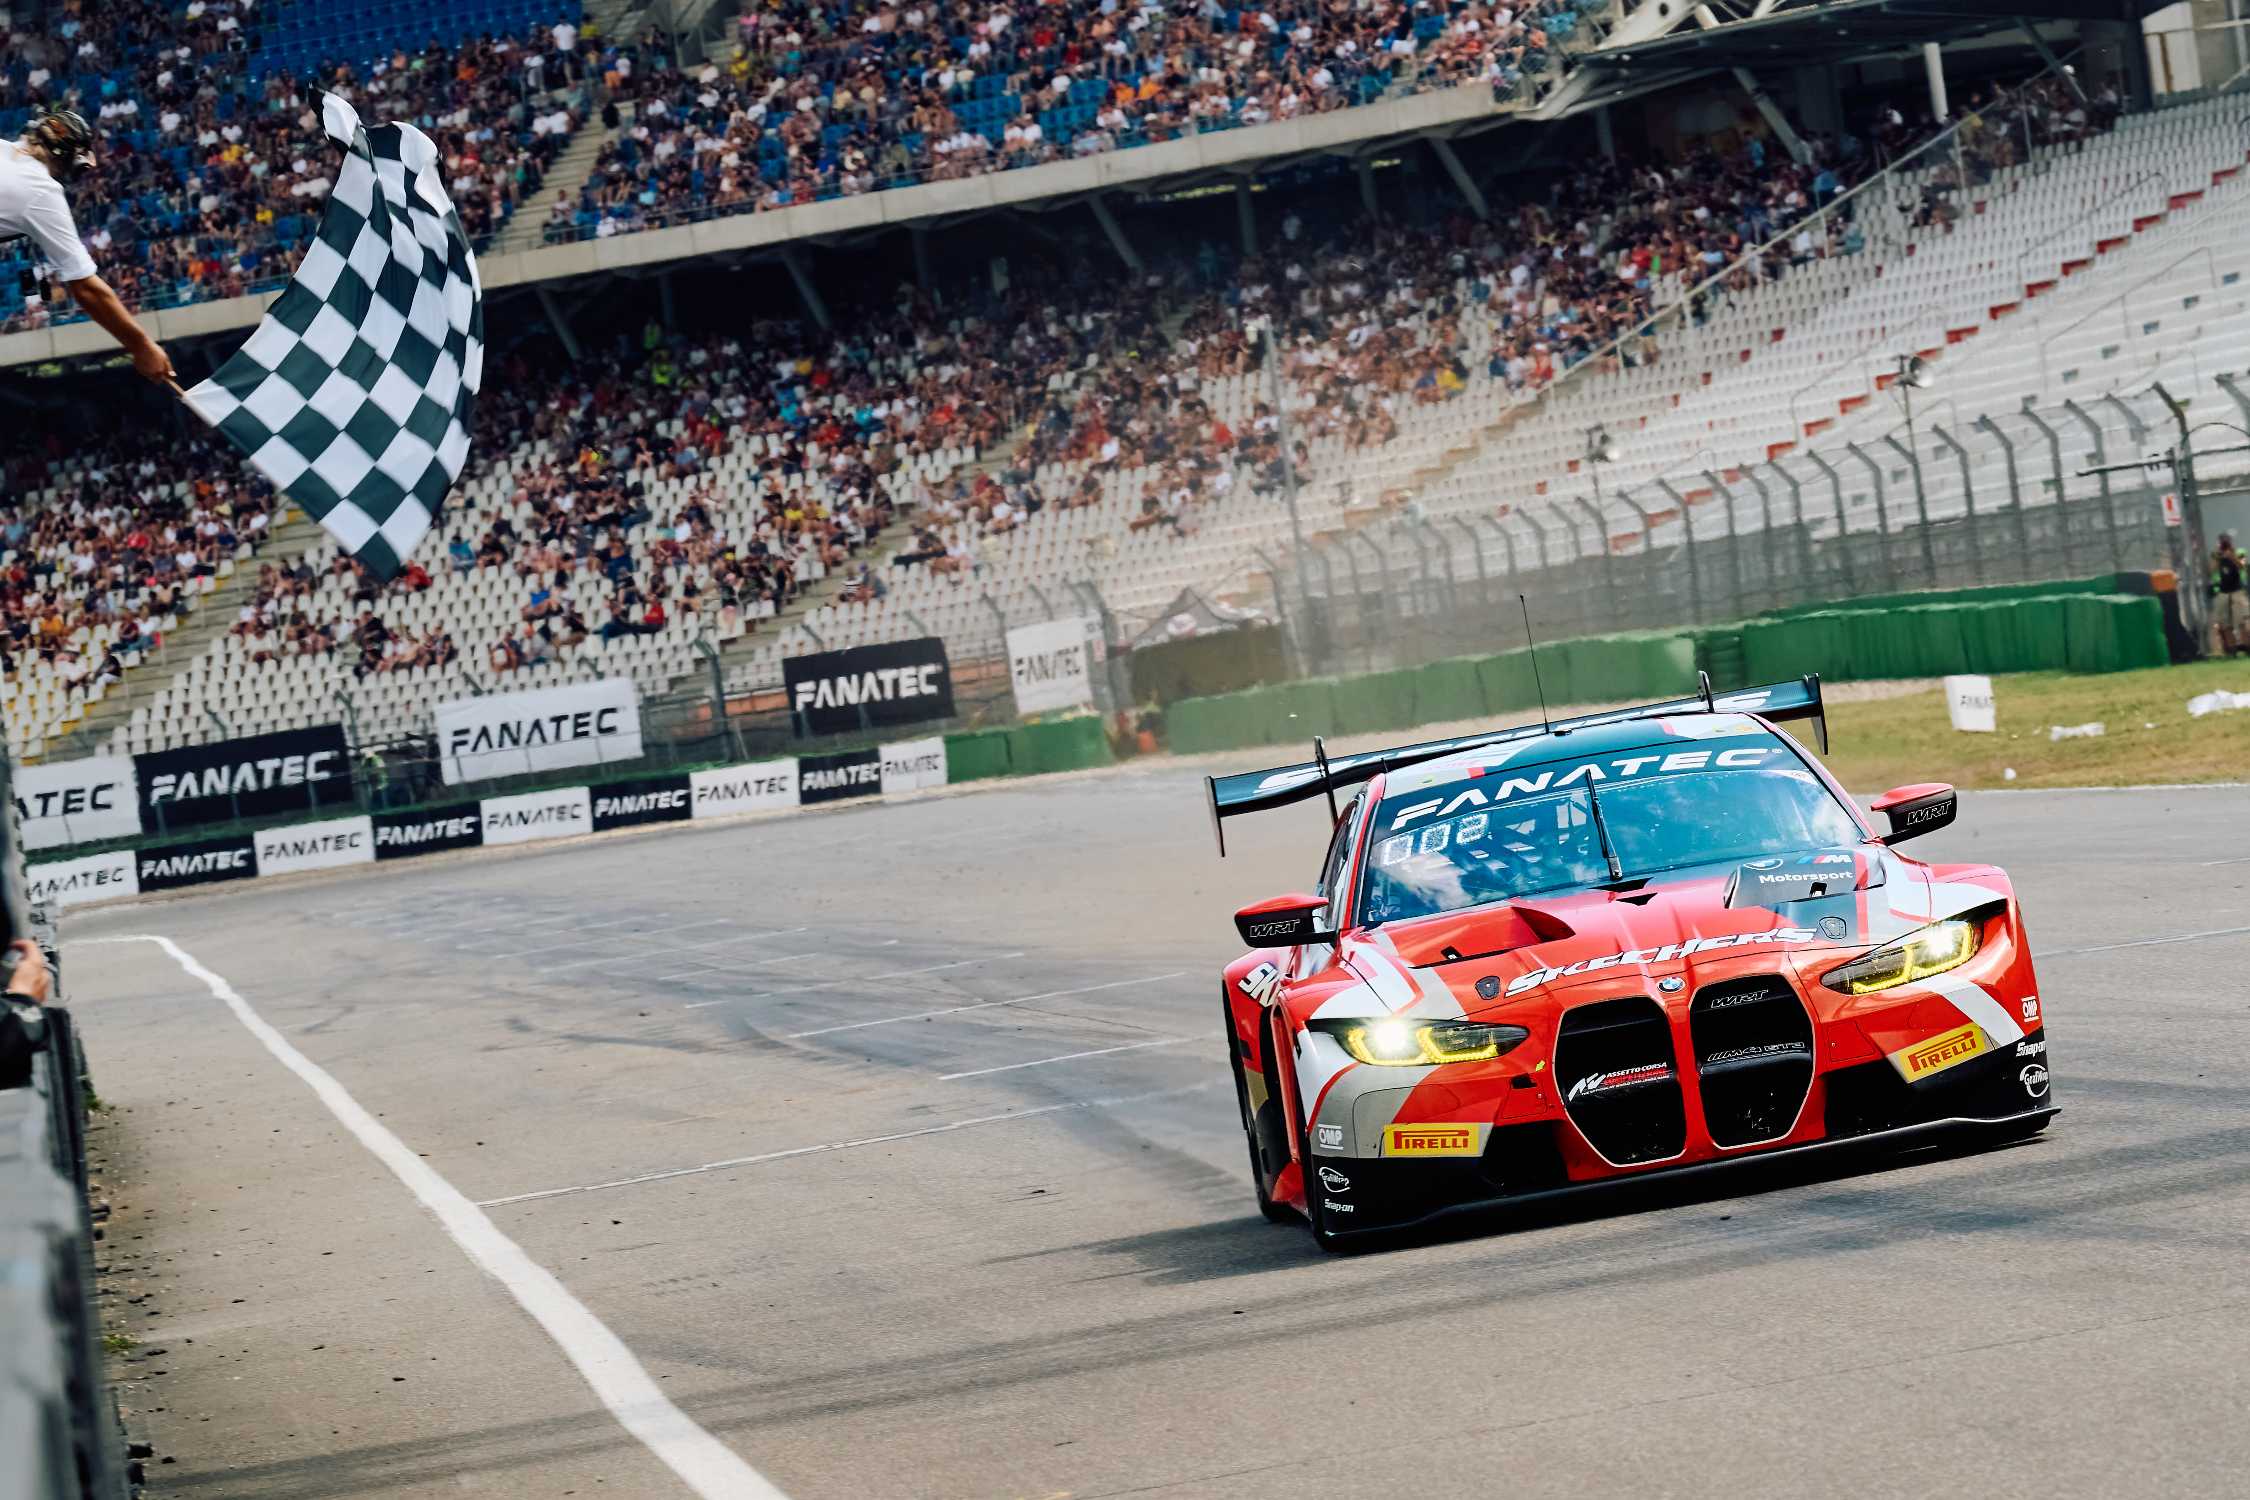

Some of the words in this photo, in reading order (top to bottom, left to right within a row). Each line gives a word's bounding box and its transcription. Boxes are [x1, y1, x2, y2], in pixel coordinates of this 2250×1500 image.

[796, 663, 938, 711] FANATEC
[451, 707, 618, 755] FANATEC
[150, 750, 334, 804] FANATEC
[697, 776, 789, 801] FANATEC
[801, 762, 880, 791] FANATEC
[1391, 748, 1768, 831] FANATEC
[486, 803, 583, 829] FANATEC
[594, 789, 688, 818] FANATEC
[1907, 800, 1952, 826] WRT
[375, 816, 476, 846] FANATEC
[263, 832, 363, 861] FANATEC
[140, 849, 249, 878] FANATEC
[1758, 871, 1855, 884] Motorsport
[1250, 918, 1300, 938] WRT
[1504, 927, 1819, 998] SKECHERS
[2022, 999, 2038, 1018] OMP
[1908, 1030, 1977, 1073] PIRELLI
[1606, 1065, 1641, 1078] ASSETTO
[1641, 1061, 1668, 1072] CORSA
[1319, 1128, 1343, 1146] OMP
[1393, 1129, 1470, 1150] PIRELLI
[1324, 1198, 1355, 1213] Snap-on
